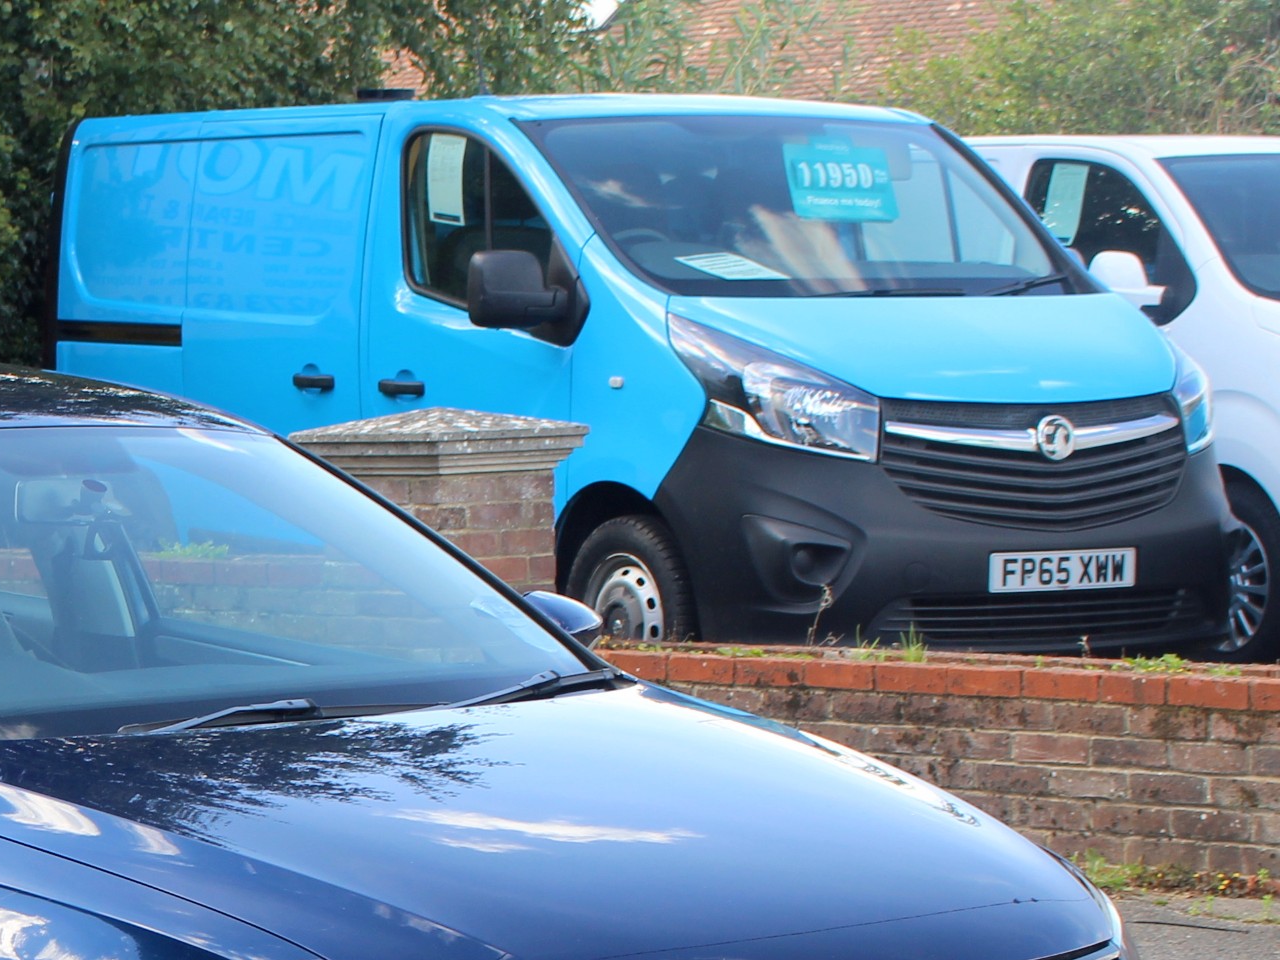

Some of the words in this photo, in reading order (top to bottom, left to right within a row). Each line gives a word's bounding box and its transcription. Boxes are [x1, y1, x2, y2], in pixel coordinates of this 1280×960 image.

[798, 162, 873, 189] 11950
[1001, 556, 1071, 587] FP65
[1078, 553, 1126, 584] XWW
